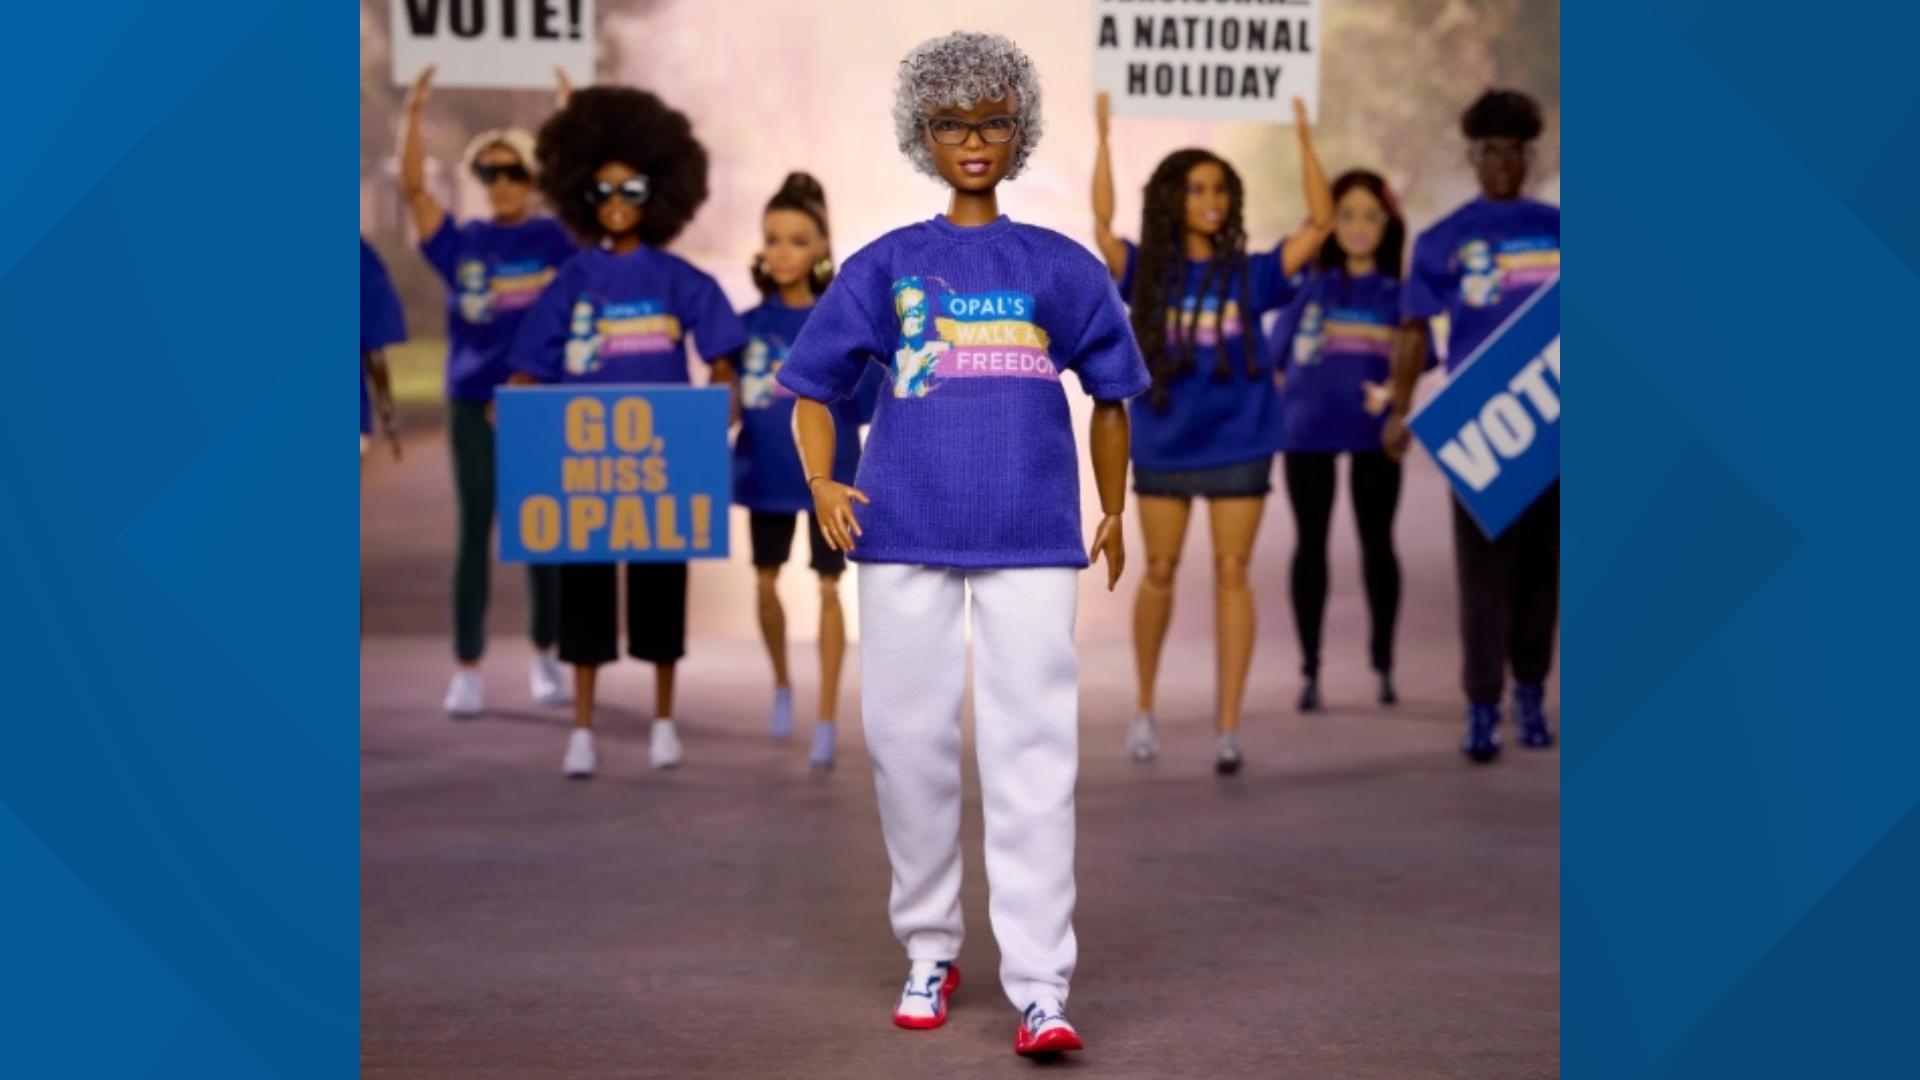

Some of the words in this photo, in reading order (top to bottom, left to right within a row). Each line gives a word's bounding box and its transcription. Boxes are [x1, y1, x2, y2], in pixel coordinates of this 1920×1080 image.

[402, 0, 581, 40] VOTE!
[1098, 15, 1118, 48] A
[1134, 15, 1311, 53] NATIONAL
[1127, 62, 1281, 98] HOLIDAY
[949, 297, 1025, 316] OPAL'S
[956, 324, 1017, 344] WALK
[956, 352, 1056, 375] FREEDO
[564, 396, 664, 455] GO,
[561, 456, 668, 493] MISS
[519, 494, 712, 552] OPAL!
